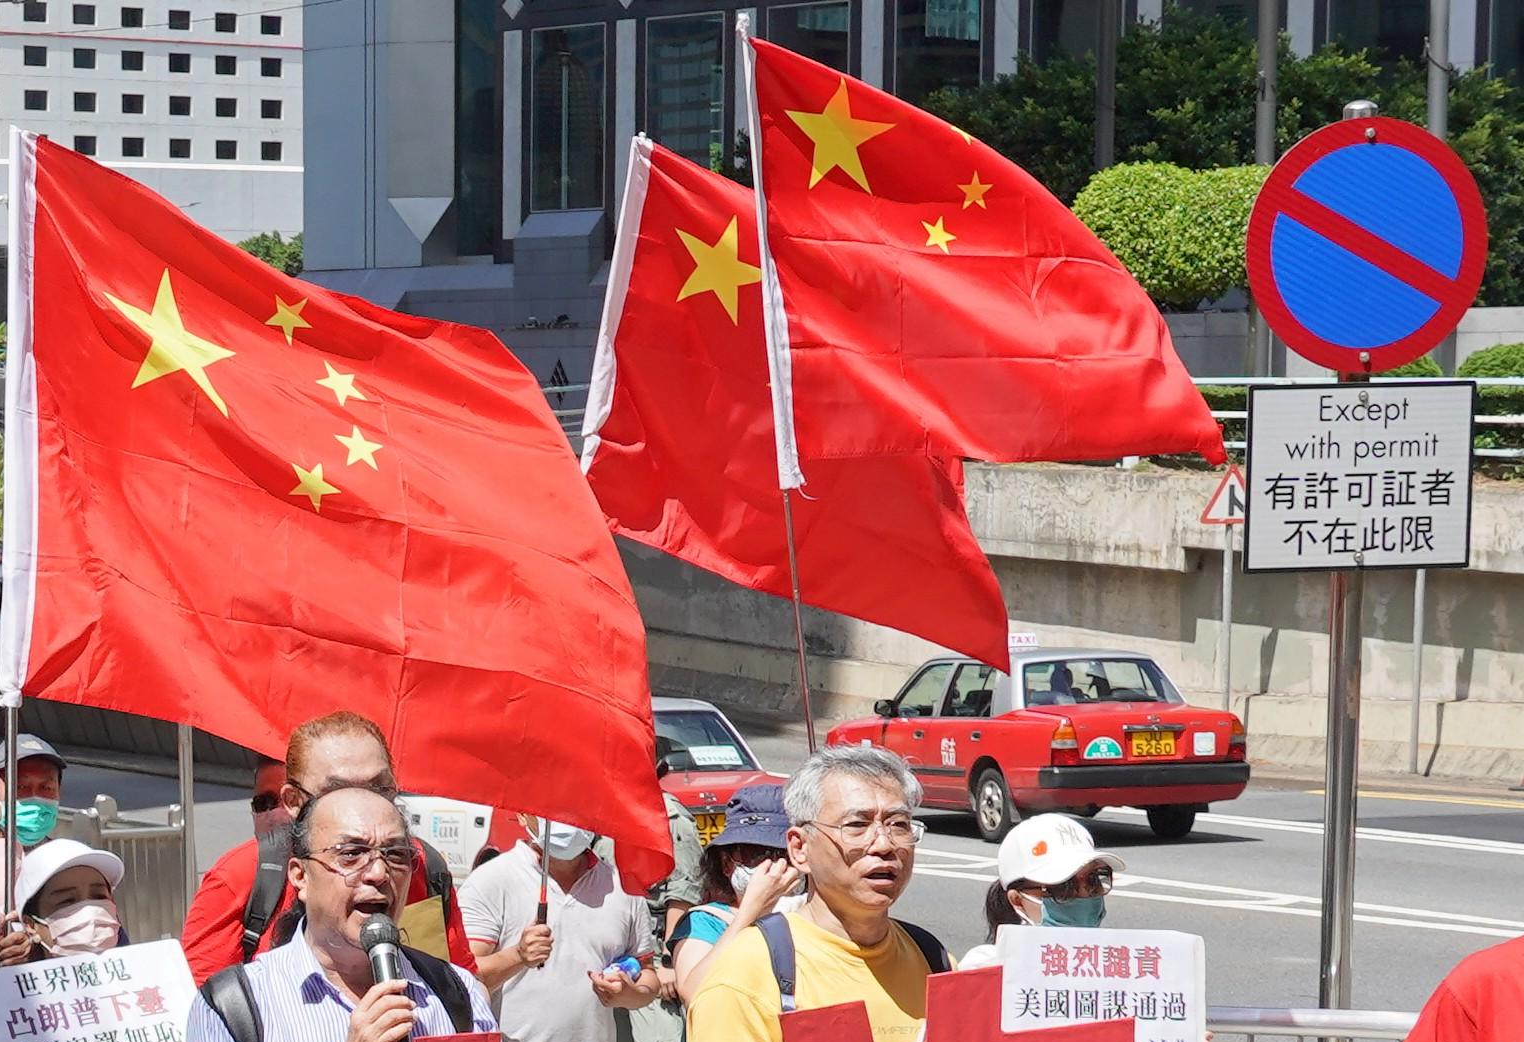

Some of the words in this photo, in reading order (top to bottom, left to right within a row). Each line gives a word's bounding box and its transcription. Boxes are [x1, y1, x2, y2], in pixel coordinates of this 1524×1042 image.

[1319, 395, 1409, 428] Except
[1284, 431, 1340, 460] with
[1354, 432, 1439, 467] permit
[1264, 469, 1455, 510] 有許可証者
[1283, 516, 1434, 556] 不在此限
[1011, 636, 1036, 644] TAXI
[1136, 743, 1172, 755] 5260
[1145, 732, 1163, 742] JU
[13, 957, 132, 999] 世界魔鬼
[1040, 943, 1162, 980] 強烈譴責
[5, 984, 169, 1040] 凸朗普下臺
[1015, 987, 1188, 1022] 美國圖謀通過
